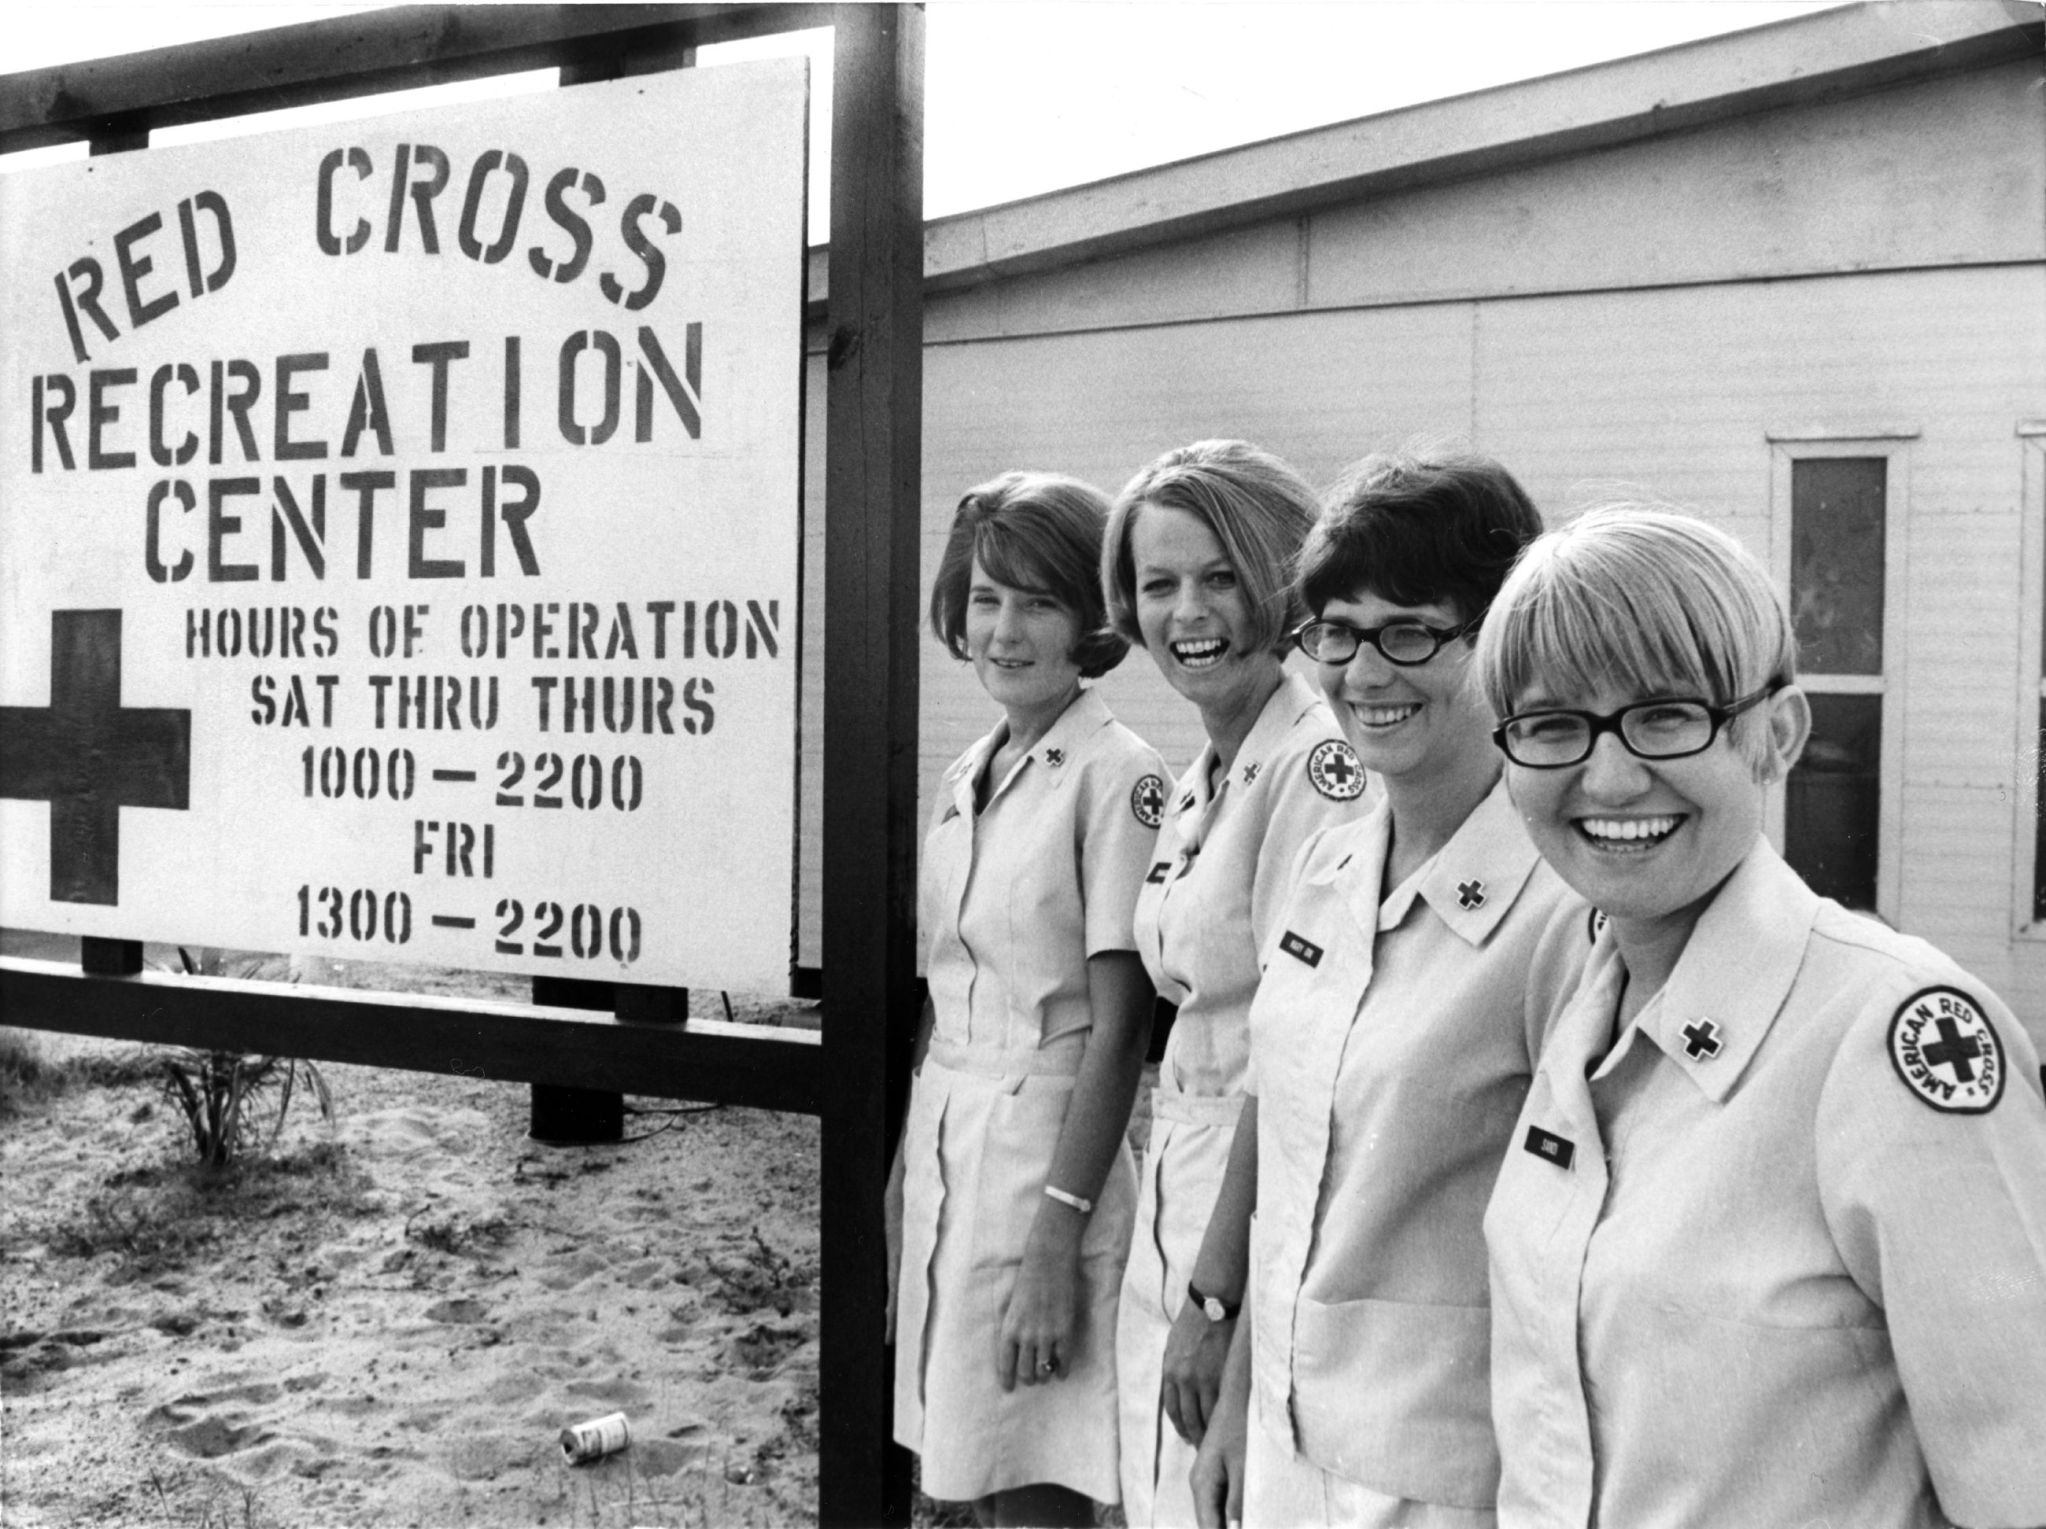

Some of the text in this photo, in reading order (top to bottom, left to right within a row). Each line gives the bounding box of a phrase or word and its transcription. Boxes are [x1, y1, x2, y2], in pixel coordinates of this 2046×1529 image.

[55, 144, 683, 363] RED CROSS
[32, 322, 703, 473] RECREATION
[145, 465, 541, 583] CENTER
[186, 600, 779, 659] HOURS OF OPERATION
[251, 674, 715, 736] SAT THRU THURS
[301, 746, 415, 801] 1000
[495, 750, 643, 812] 2200
[1313, 745, 1336, 791] AMERICAN
[1336, 745, 1355, 761] RED
[413, 819, 495, 878] FRI
[297, 884, 412, 944] 1300
[495, 898, 642, 963] 2200
[1900, 997, 1995, 1101] AMERICAN RED CROSS
